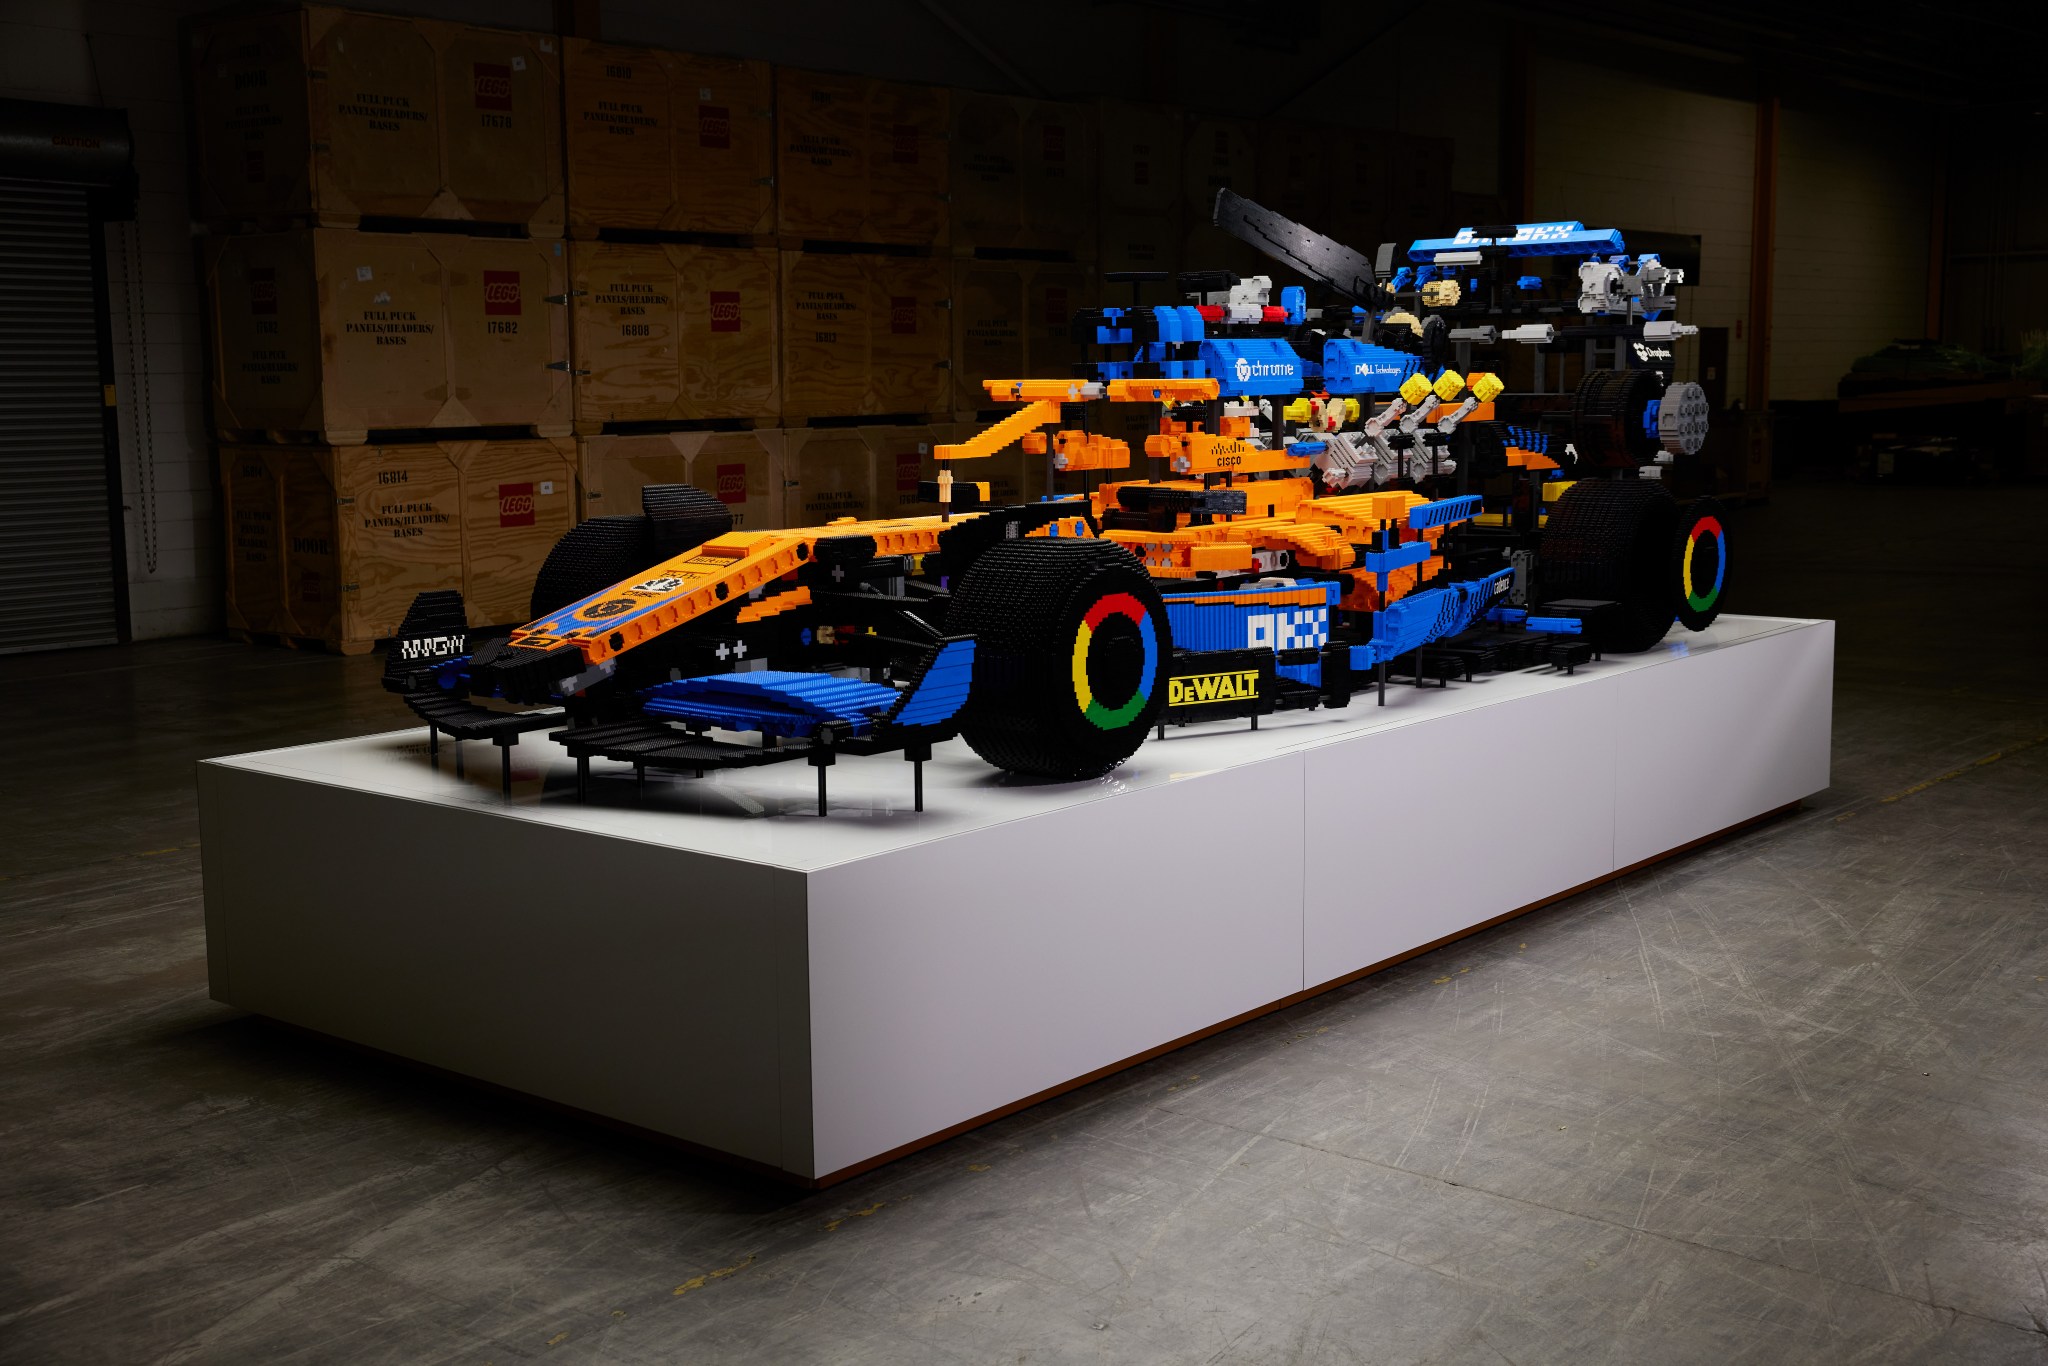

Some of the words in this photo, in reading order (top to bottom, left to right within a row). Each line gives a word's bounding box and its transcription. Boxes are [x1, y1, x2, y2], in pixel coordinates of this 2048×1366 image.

[606, 64, 632, 79] 16810
[234, 70, 268, 89] DOOR
[477, 78, 509, 98] LEGO
[356, 93, 382, 104] FULL
[383, 95, 409, 108] PUCK
[599, 101, 619, 111] FULL
[620, 103, 643, 113] PUCK
[338, 105, 428, 121] PANELS/HEADERS/
[369, 120, 400, 131] BASES
[609, 125, 635, 136] BASES
[701, 117, 729, 137] LEGO
[52, 135, 100, 149] CAUTION
[895, 135, 918, 152] LEGO
[1512, 225, 1574, 241] OKX
[249, 281, 278, 300] LEGO
[485, 283, 520, 303] LEGO
[610, 284, 630, 293] FULL
[632, 284, 653, 293] PUCK
[595, 294, 668, 305] PANELS/HEADERS/
[808, 291, 824, 300] FULL
[825, 291, 845, 301] PUCK
[364, 311, 387, 321] FULL
[390, 312, 416, 322] PUCK
[619, 306, 645, 315] BASES
[711, 303, 740, 321] LEGO
[816, 313, 837, 321] BASES
[892, 307, 917, 324] LEGO
[256, 320, 279, 335] 17682
[346, 323, 434, 335] PANELS/HEADERS/
[487, 321, 518, 335] 17682
[622, 323, 650, 337] 16808
[376, 336, 407, 346] BASES
[1645, 347, 1671, 361] Dropbox
[1252, 360, 1294, 377] chrome
[1355, 363, 1374, 377] DELL
[1375, 364, 1401, 377] Technologies
[1217, 456, 1241, 467] CISCO
[378, 471, 408, 485] 16814
[898, 463, 921, 481] LEGO
[718, 474, 746, 493] LEGO
[382, 505, 406, 515] FULL
[407, 503, 432, 514] PUCK
[502, 495, 533, 516] LEGO
[365, 514, 450, 528] PANELS/HEADERS/
[394, 528, 424, 539] BASES
[293, 536, 329, 556] DOOR
[1247, 608, 1327, 651] OKX
